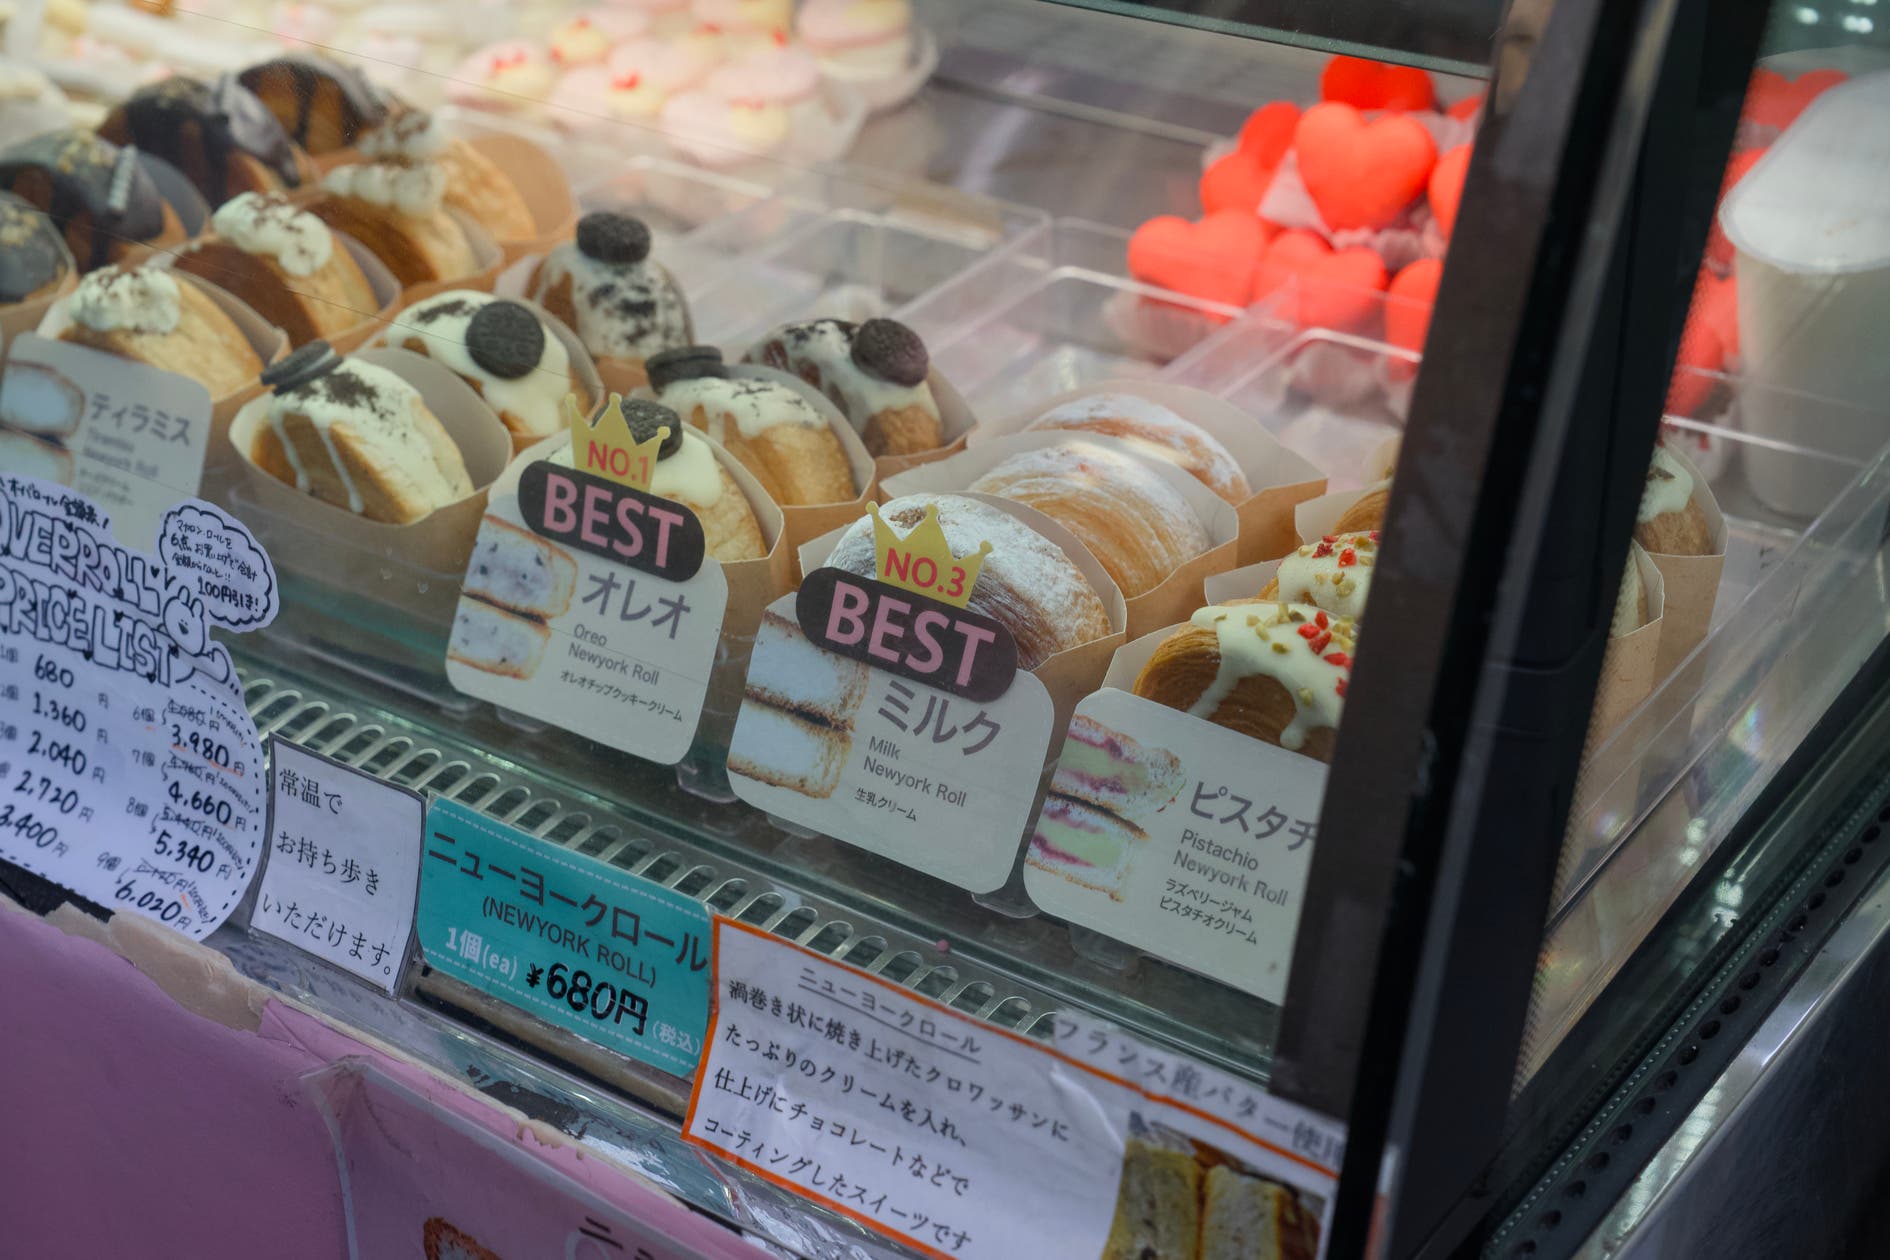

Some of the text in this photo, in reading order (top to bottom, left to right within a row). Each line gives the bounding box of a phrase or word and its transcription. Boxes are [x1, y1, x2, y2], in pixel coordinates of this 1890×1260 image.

[90, 392, 191, 447] ティラミス
[587, 439, 650, 485] NO.1
[543, 472, 685, 569] BEST
[884, 547, 967, 598] NO.3
[581, 571, 691, 640] オレオ
[825, 580, 997, 688] BEST
[568, 642, 660, 686] Newyork Roll
[573, 623, 608, 648] Oreo
[34, 653, 75, 689] 680
[560, 669, 683, 722] オレオチップクッキークリーム
[877, 679, 1002, 756] ミルク
[868, 735, 902, 761] Milk
[279, 767, 344, 815] 常温で
[854, 787, 917, 822] 生乳クリーム
[863, 755, 968, 807] Newyork Roll
[275, 830, 380, 897] お持ち歩き
[1172, 850, 1289, 907] Newyork Roll
[1180, 828, 1260, 872] Pistachio
[428, 831, 709, 973] ニューヨークロール
[1158, 894, 1258, 946] ピスタチオクリーム
[1165, 877, 1254, 923] ラズベリージャム
[261, 893, 392, 977] いただけます。
[482, 895, 658, 990] (NEWYORK ROLL)
[525, 961, 650, 1037] ¥680円
[651, 1019, 701, 1057] (税込)
[799, 965, 983, 1056] ニューヨークロール
[724, 1022, 969, 1149] たっぷりのクリームを入れ、
[727, 977, 1071, 1143] 渦巻き状に焼き上げたクロワッサンに
[713, 1066, 971, 1197] 仕上げにチョコレートなどで
[703, 1115, 973, 1251] コーティングしたスイーツです
